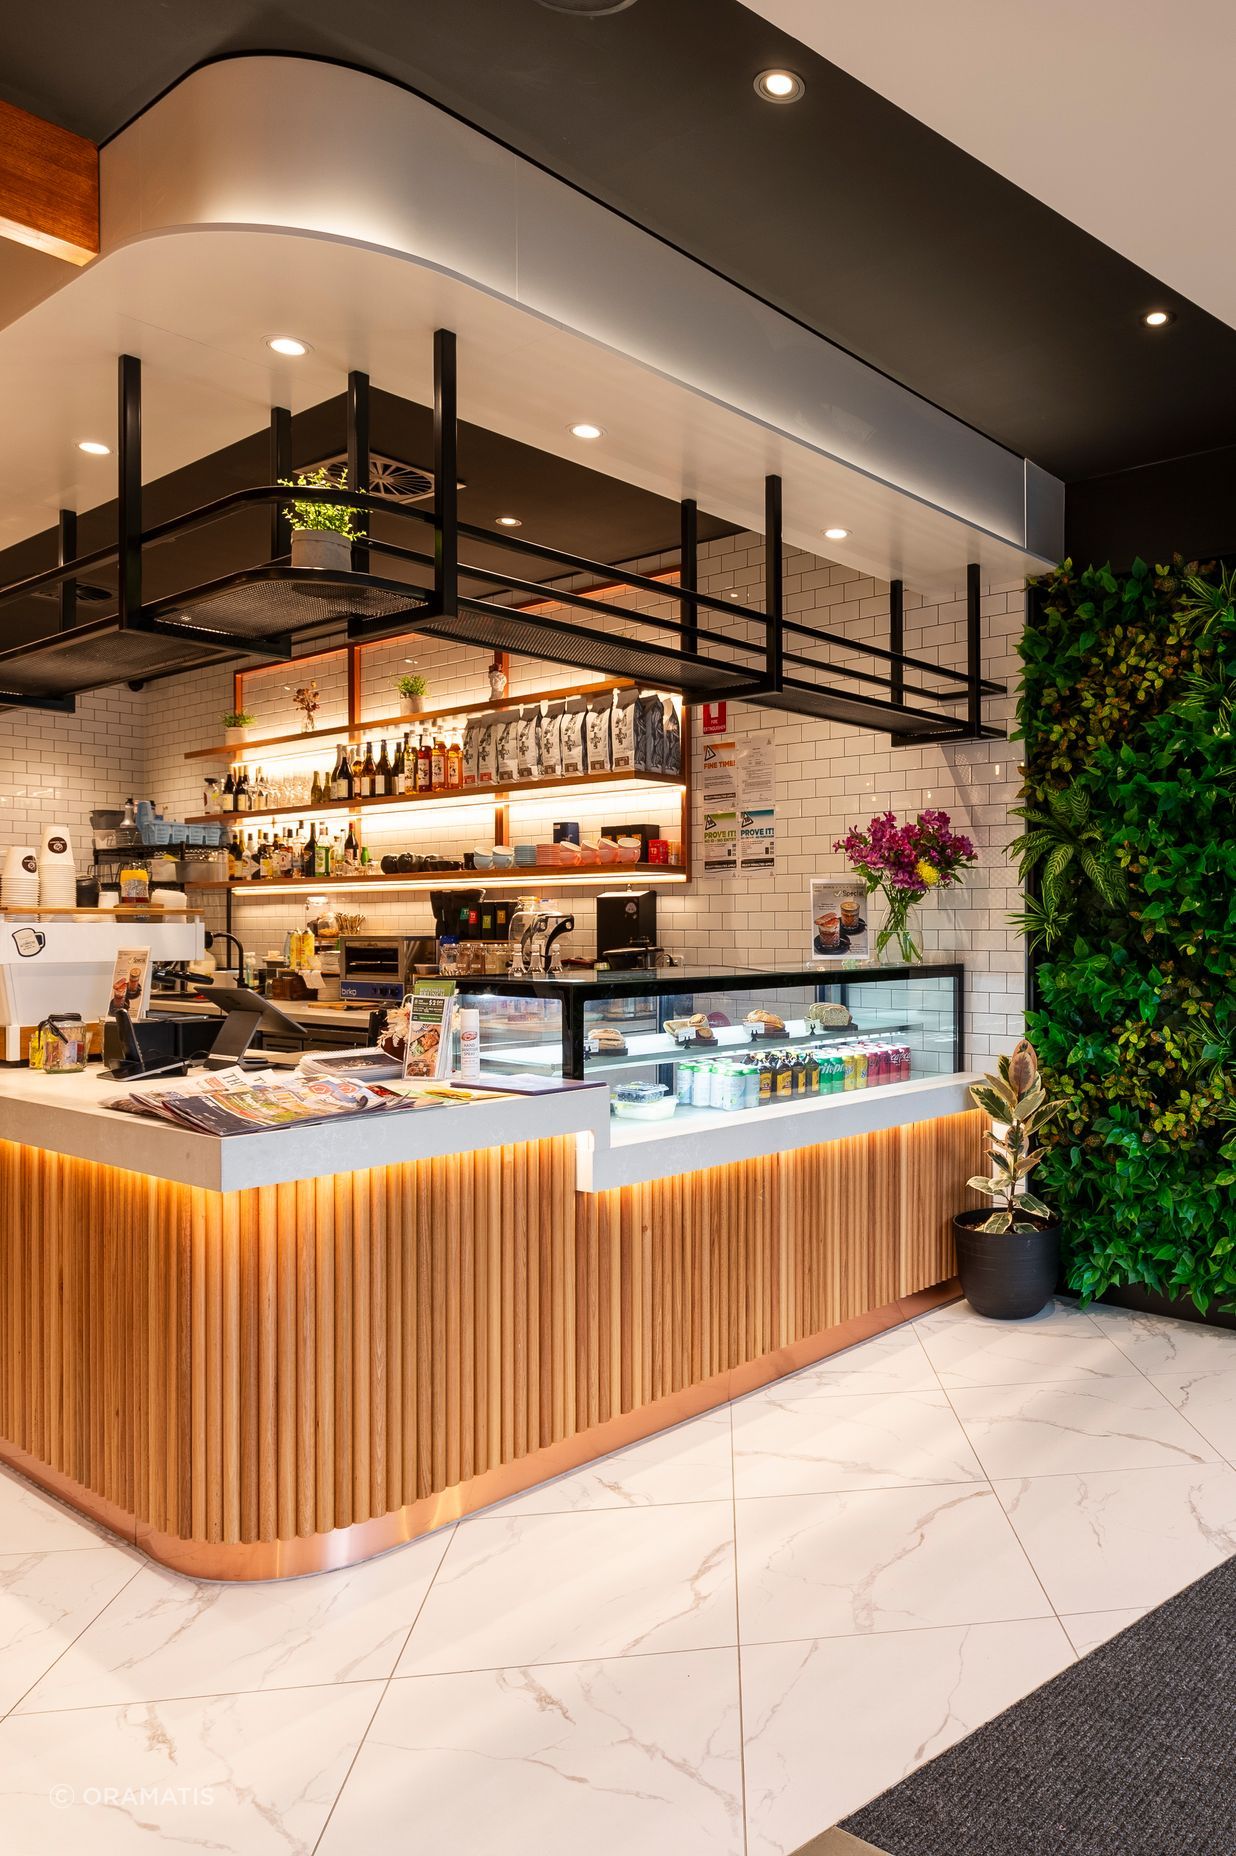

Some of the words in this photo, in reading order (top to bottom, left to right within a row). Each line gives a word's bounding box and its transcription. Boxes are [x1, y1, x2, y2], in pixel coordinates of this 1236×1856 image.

[704, 831, 727, 839] PROVE
[741, 829, 764, 838] PROVE
[765, 827, 774, 835] IT!
